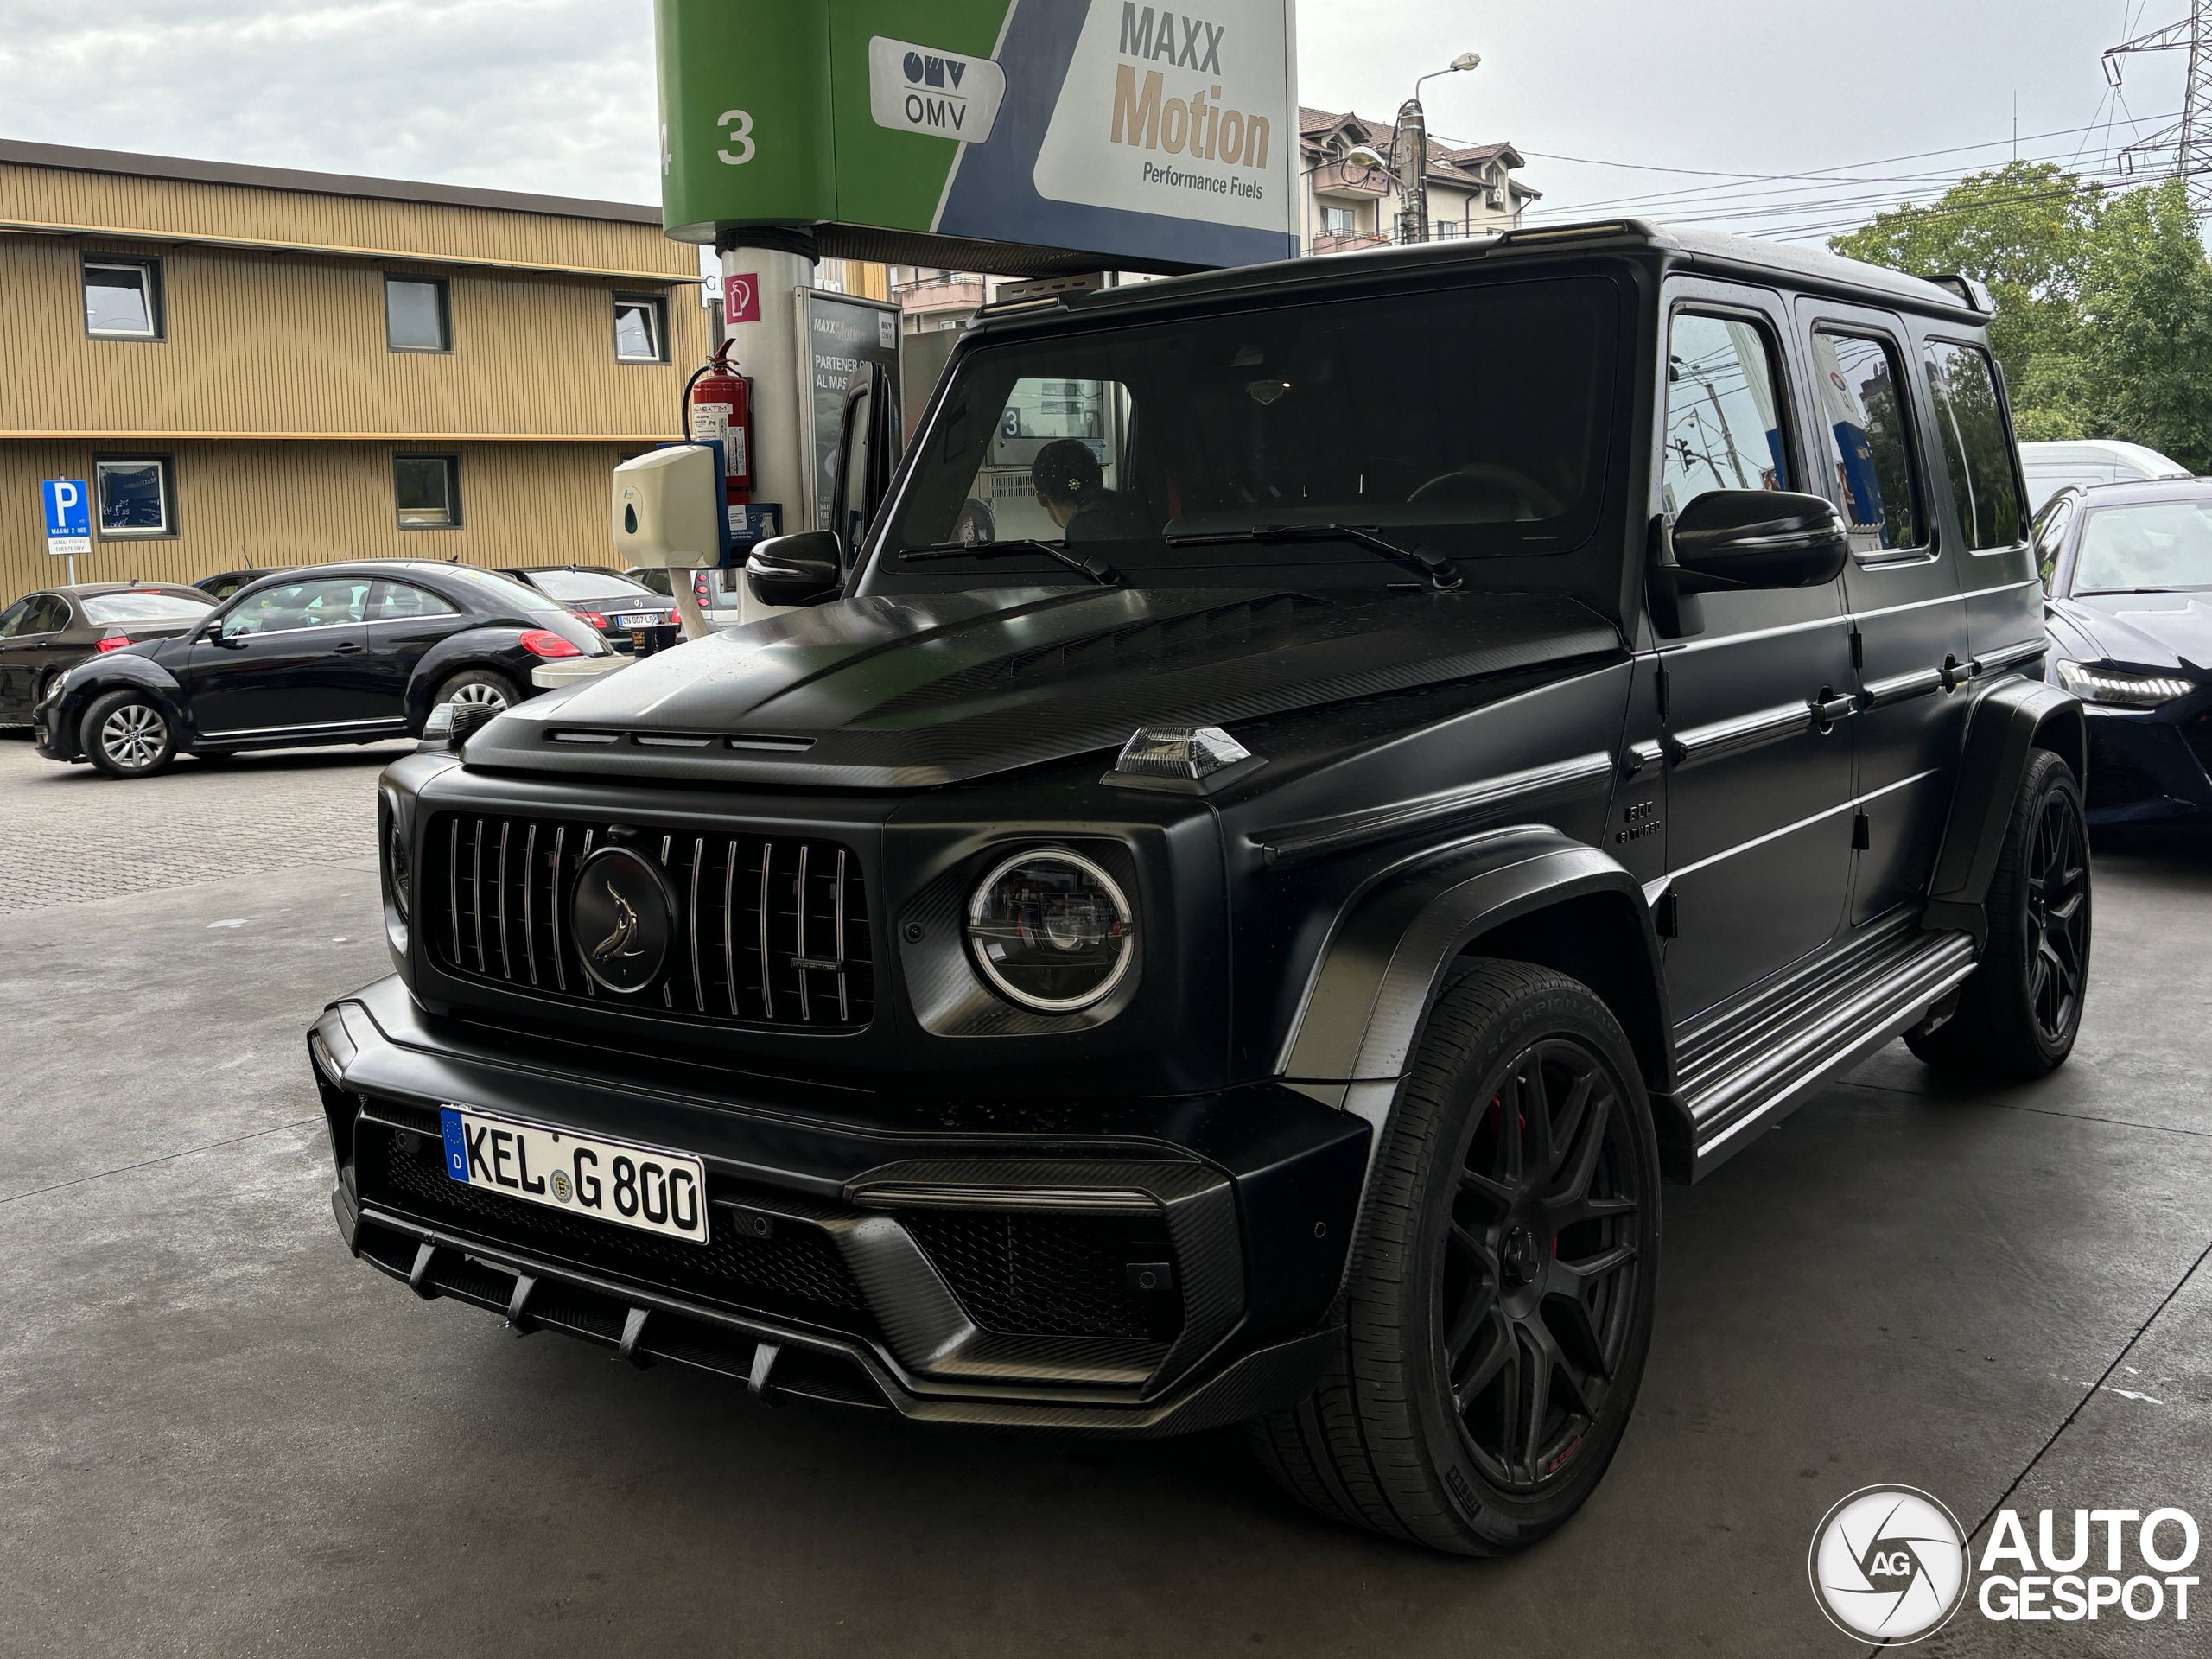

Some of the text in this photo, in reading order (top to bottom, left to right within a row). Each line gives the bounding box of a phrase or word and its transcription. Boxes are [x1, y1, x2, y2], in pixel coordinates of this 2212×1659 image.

[1119, 2, 1225, 76] MAXX
[905, 94, 966, 130] OMV
[1110, 63, 1270, 169] Motion
[717, 109, 756, 165] 3
[1142, 161, 1263, 200] Performance Fuels
[813, 318, 867, 343] MAXX Motion
[815, 354, 858, 372] PARTENER
[816, 373, 828, 389] AL
[1006, 410, 1018, 435] 3
[54, 482, 78, 527] P
[1488, 997, 1577, 1056] SCORPION
[454, 1154, 461, 1169] D
[464, 1122, 698, 1231] KEL G 800
